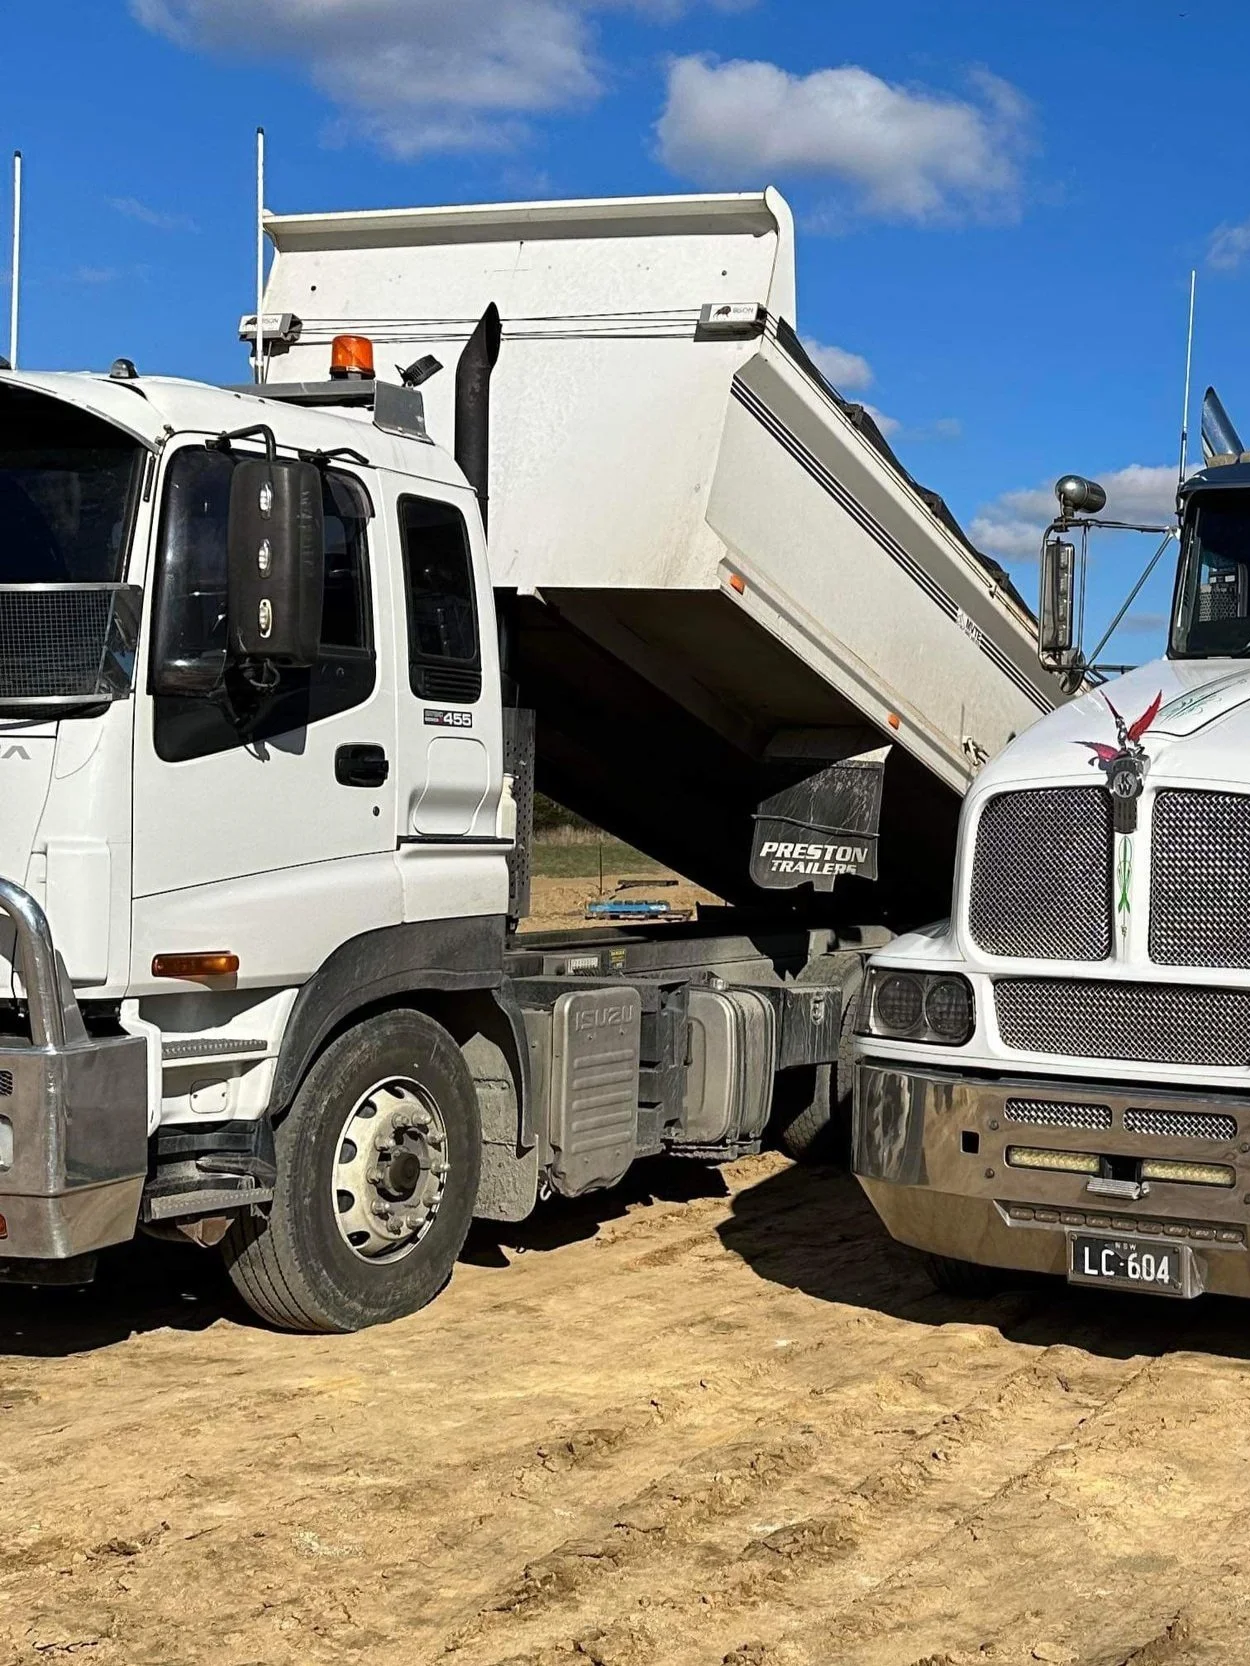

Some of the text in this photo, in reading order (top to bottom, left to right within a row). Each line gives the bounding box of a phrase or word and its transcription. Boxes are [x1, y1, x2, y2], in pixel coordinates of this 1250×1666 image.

[443, 712, 472, 726] 455
[760, 841, 868, 863] PRESTON
[771, 859, 857, 876] TRAILERS
[575, 1004, 634, 1032] ISUZU
[1115, 1242, 1137, 1251] NSW
